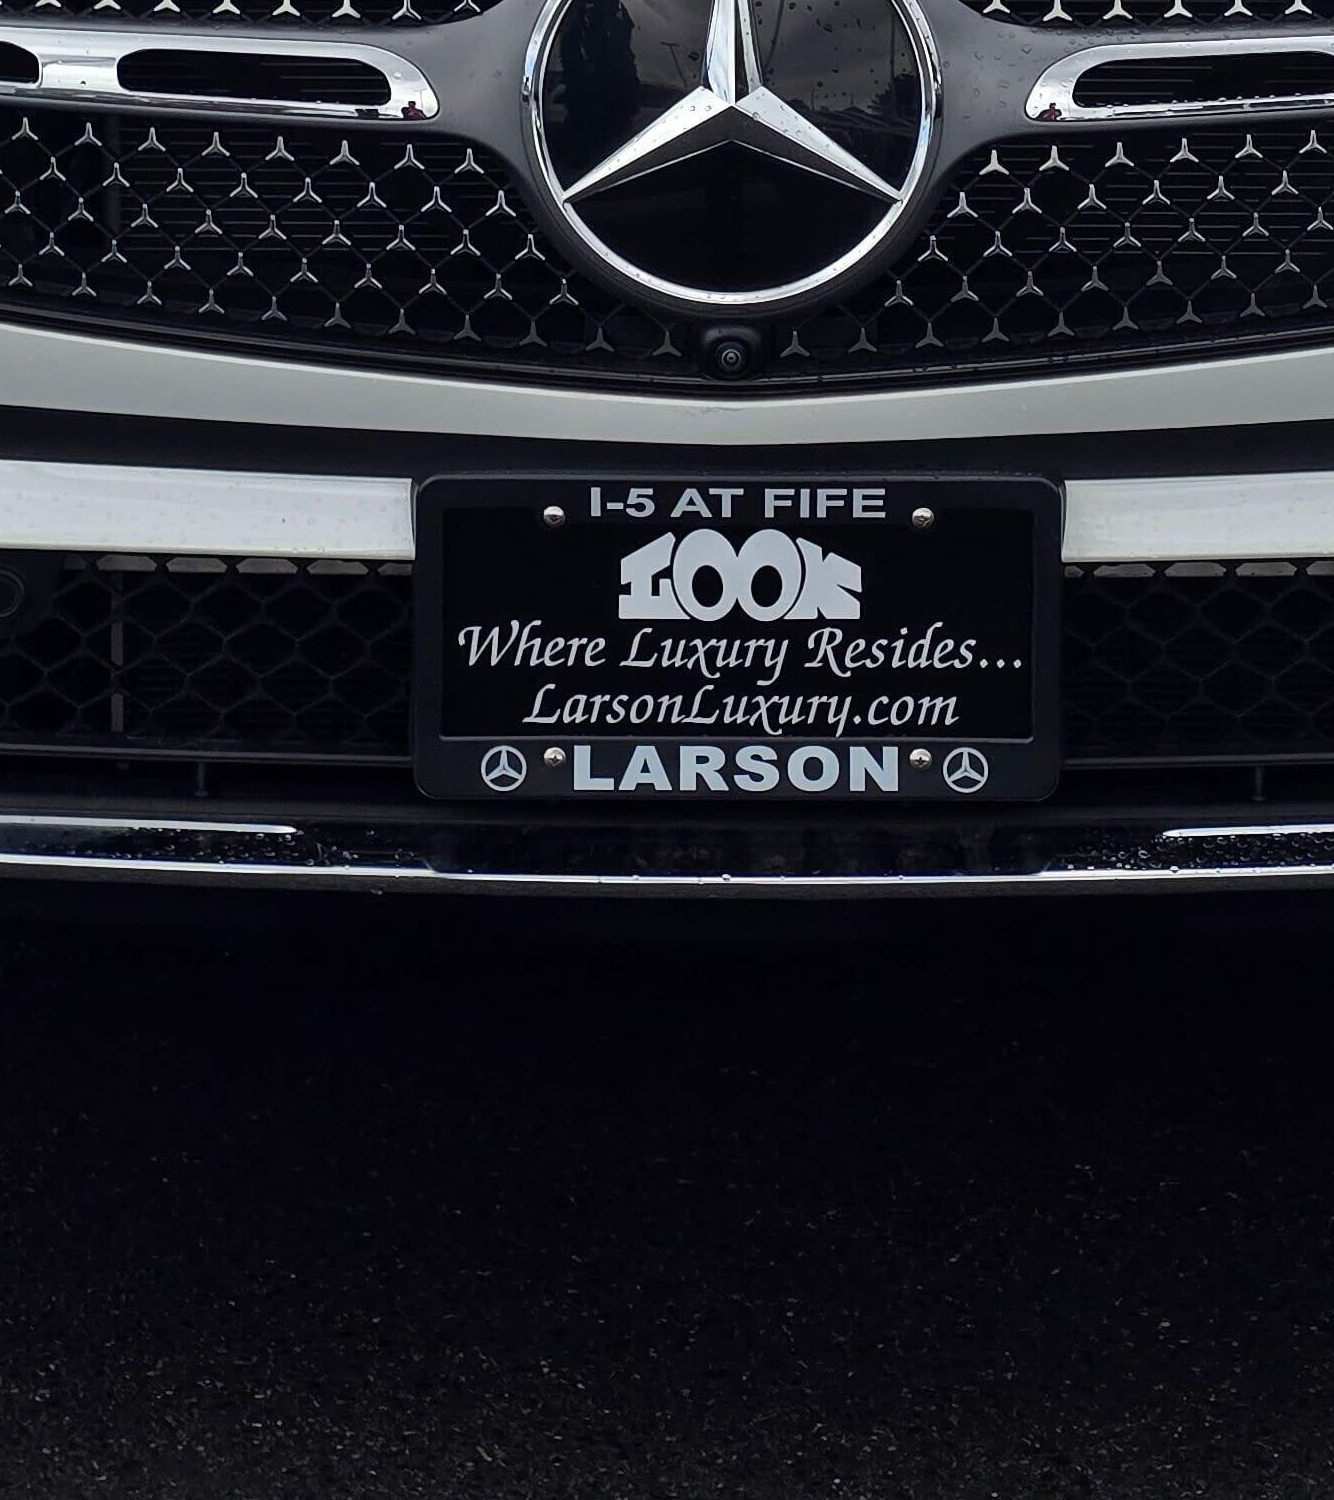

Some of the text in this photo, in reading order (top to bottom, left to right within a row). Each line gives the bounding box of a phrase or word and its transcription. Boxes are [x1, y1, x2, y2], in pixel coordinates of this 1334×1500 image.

[591, 487, 885, 517] I-5 AT FIFE
[458, 620, 1022, 685] Where Luxury Resides...
[522, 683, 960, 738] LarsonLuxury.com
[574, 745, 898, 791] LARSON
